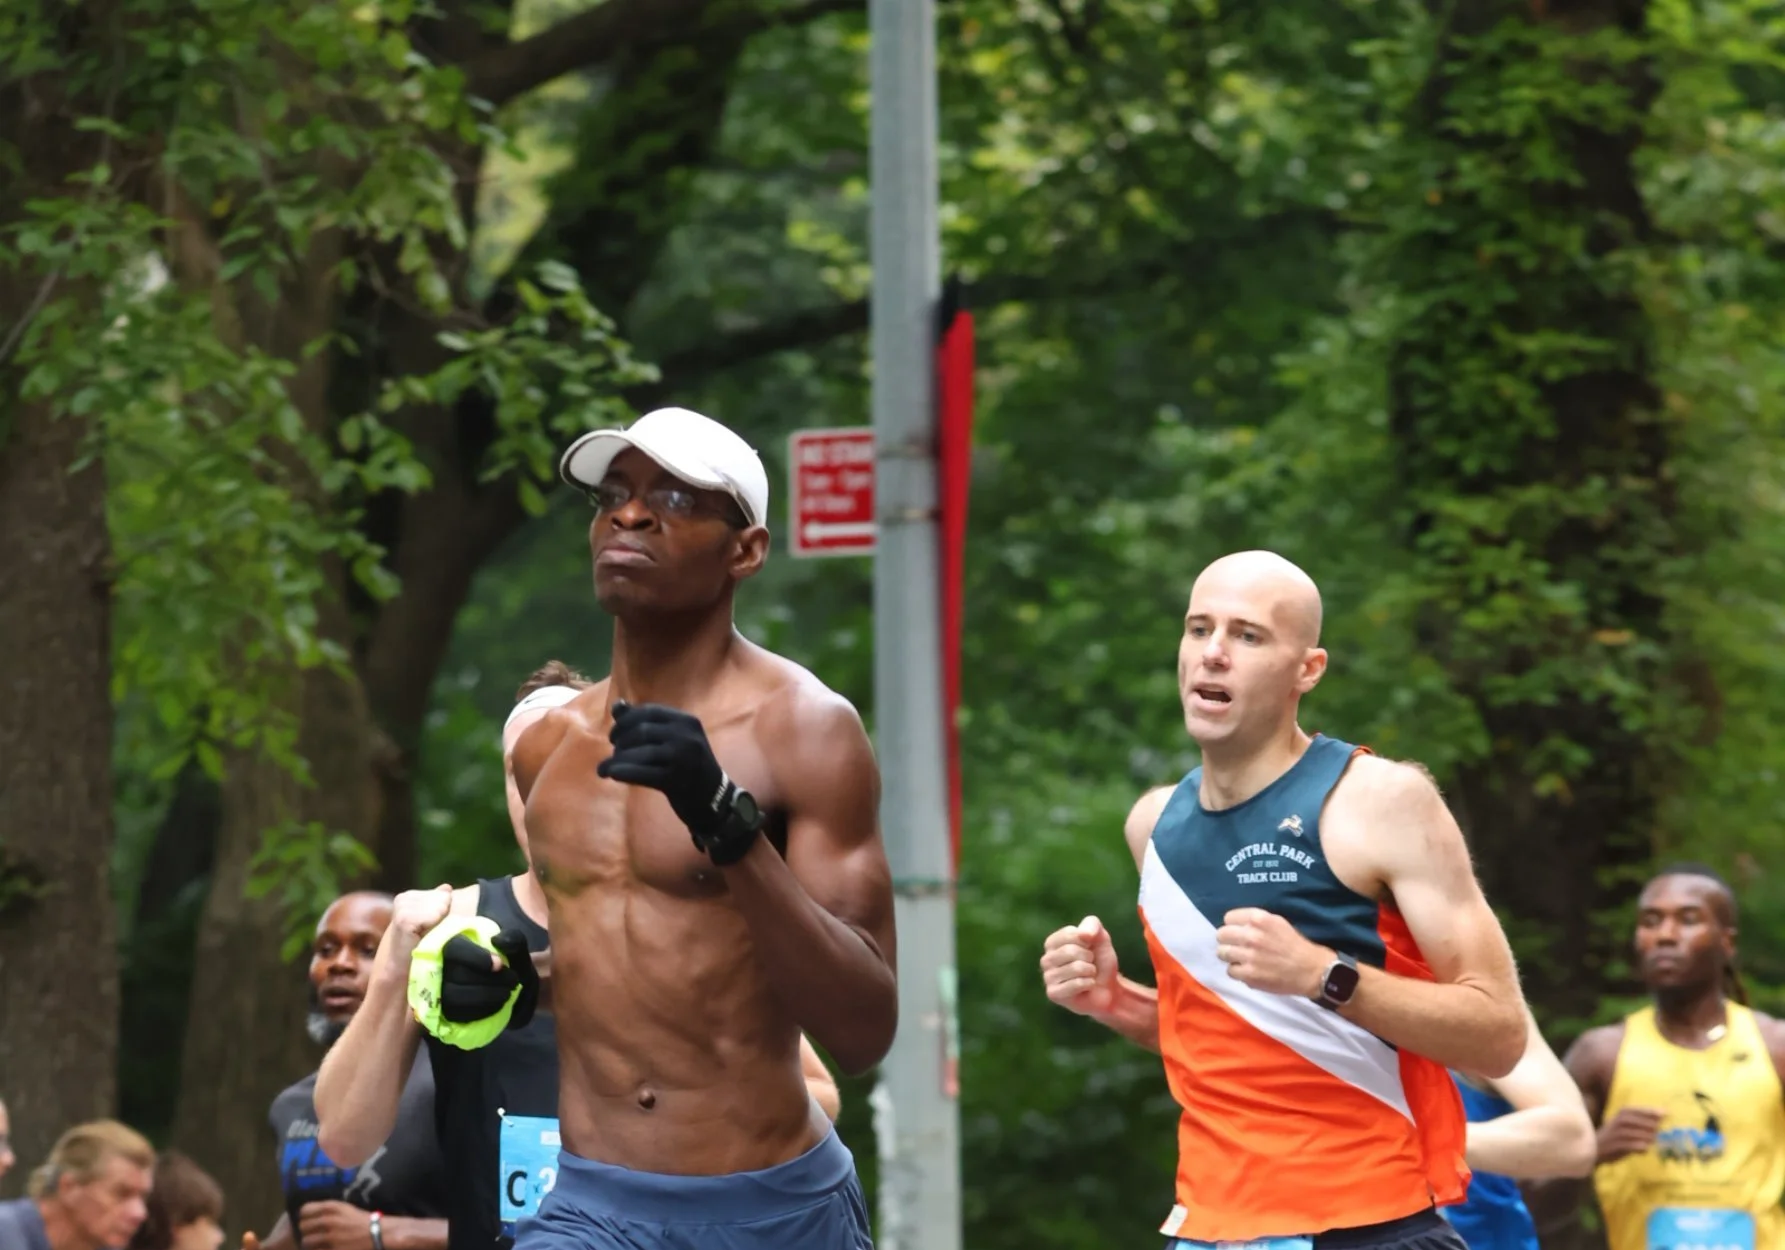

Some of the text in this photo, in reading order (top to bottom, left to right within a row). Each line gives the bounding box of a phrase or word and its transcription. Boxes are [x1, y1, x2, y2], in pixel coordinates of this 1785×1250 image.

[1225, 843, 1315, 872] CENTRAL PARK
[1237, 872, 1298, 884] TRACK CLUB
[507, 1170, 528, 1208] C
